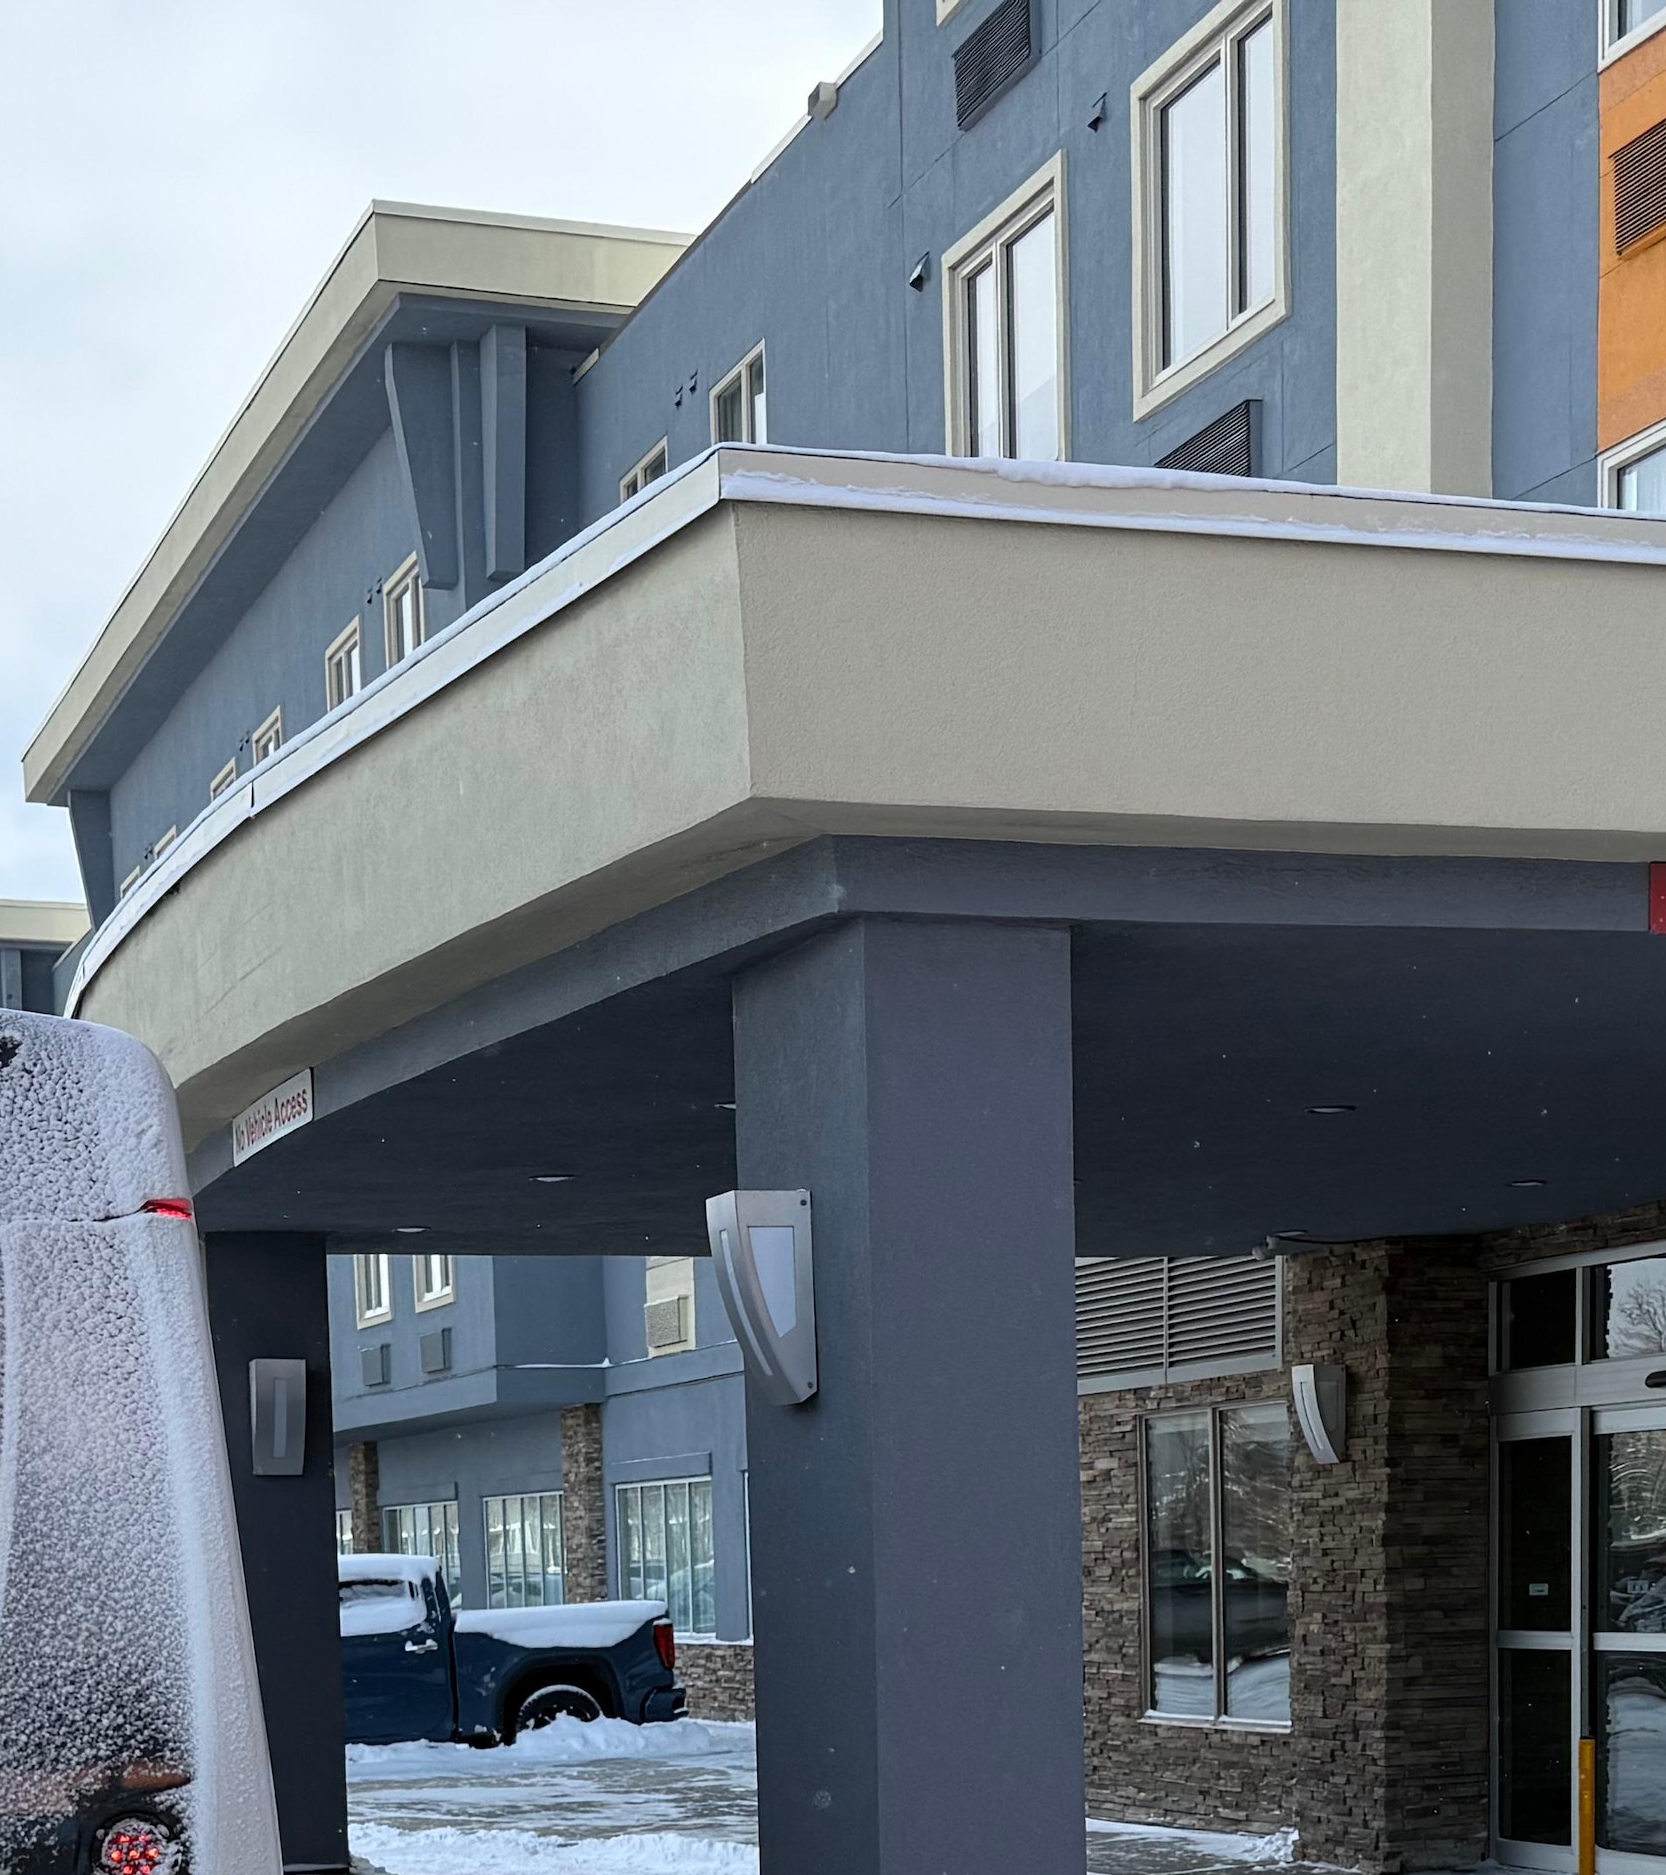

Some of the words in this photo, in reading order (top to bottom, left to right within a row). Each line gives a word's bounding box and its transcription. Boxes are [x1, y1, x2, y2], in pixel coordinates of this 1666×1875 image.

[235, 1124, 245, 1155] No
[245, 1103, 273, 1147] Vehicle
[274, 1088, 308, 1130] Access
